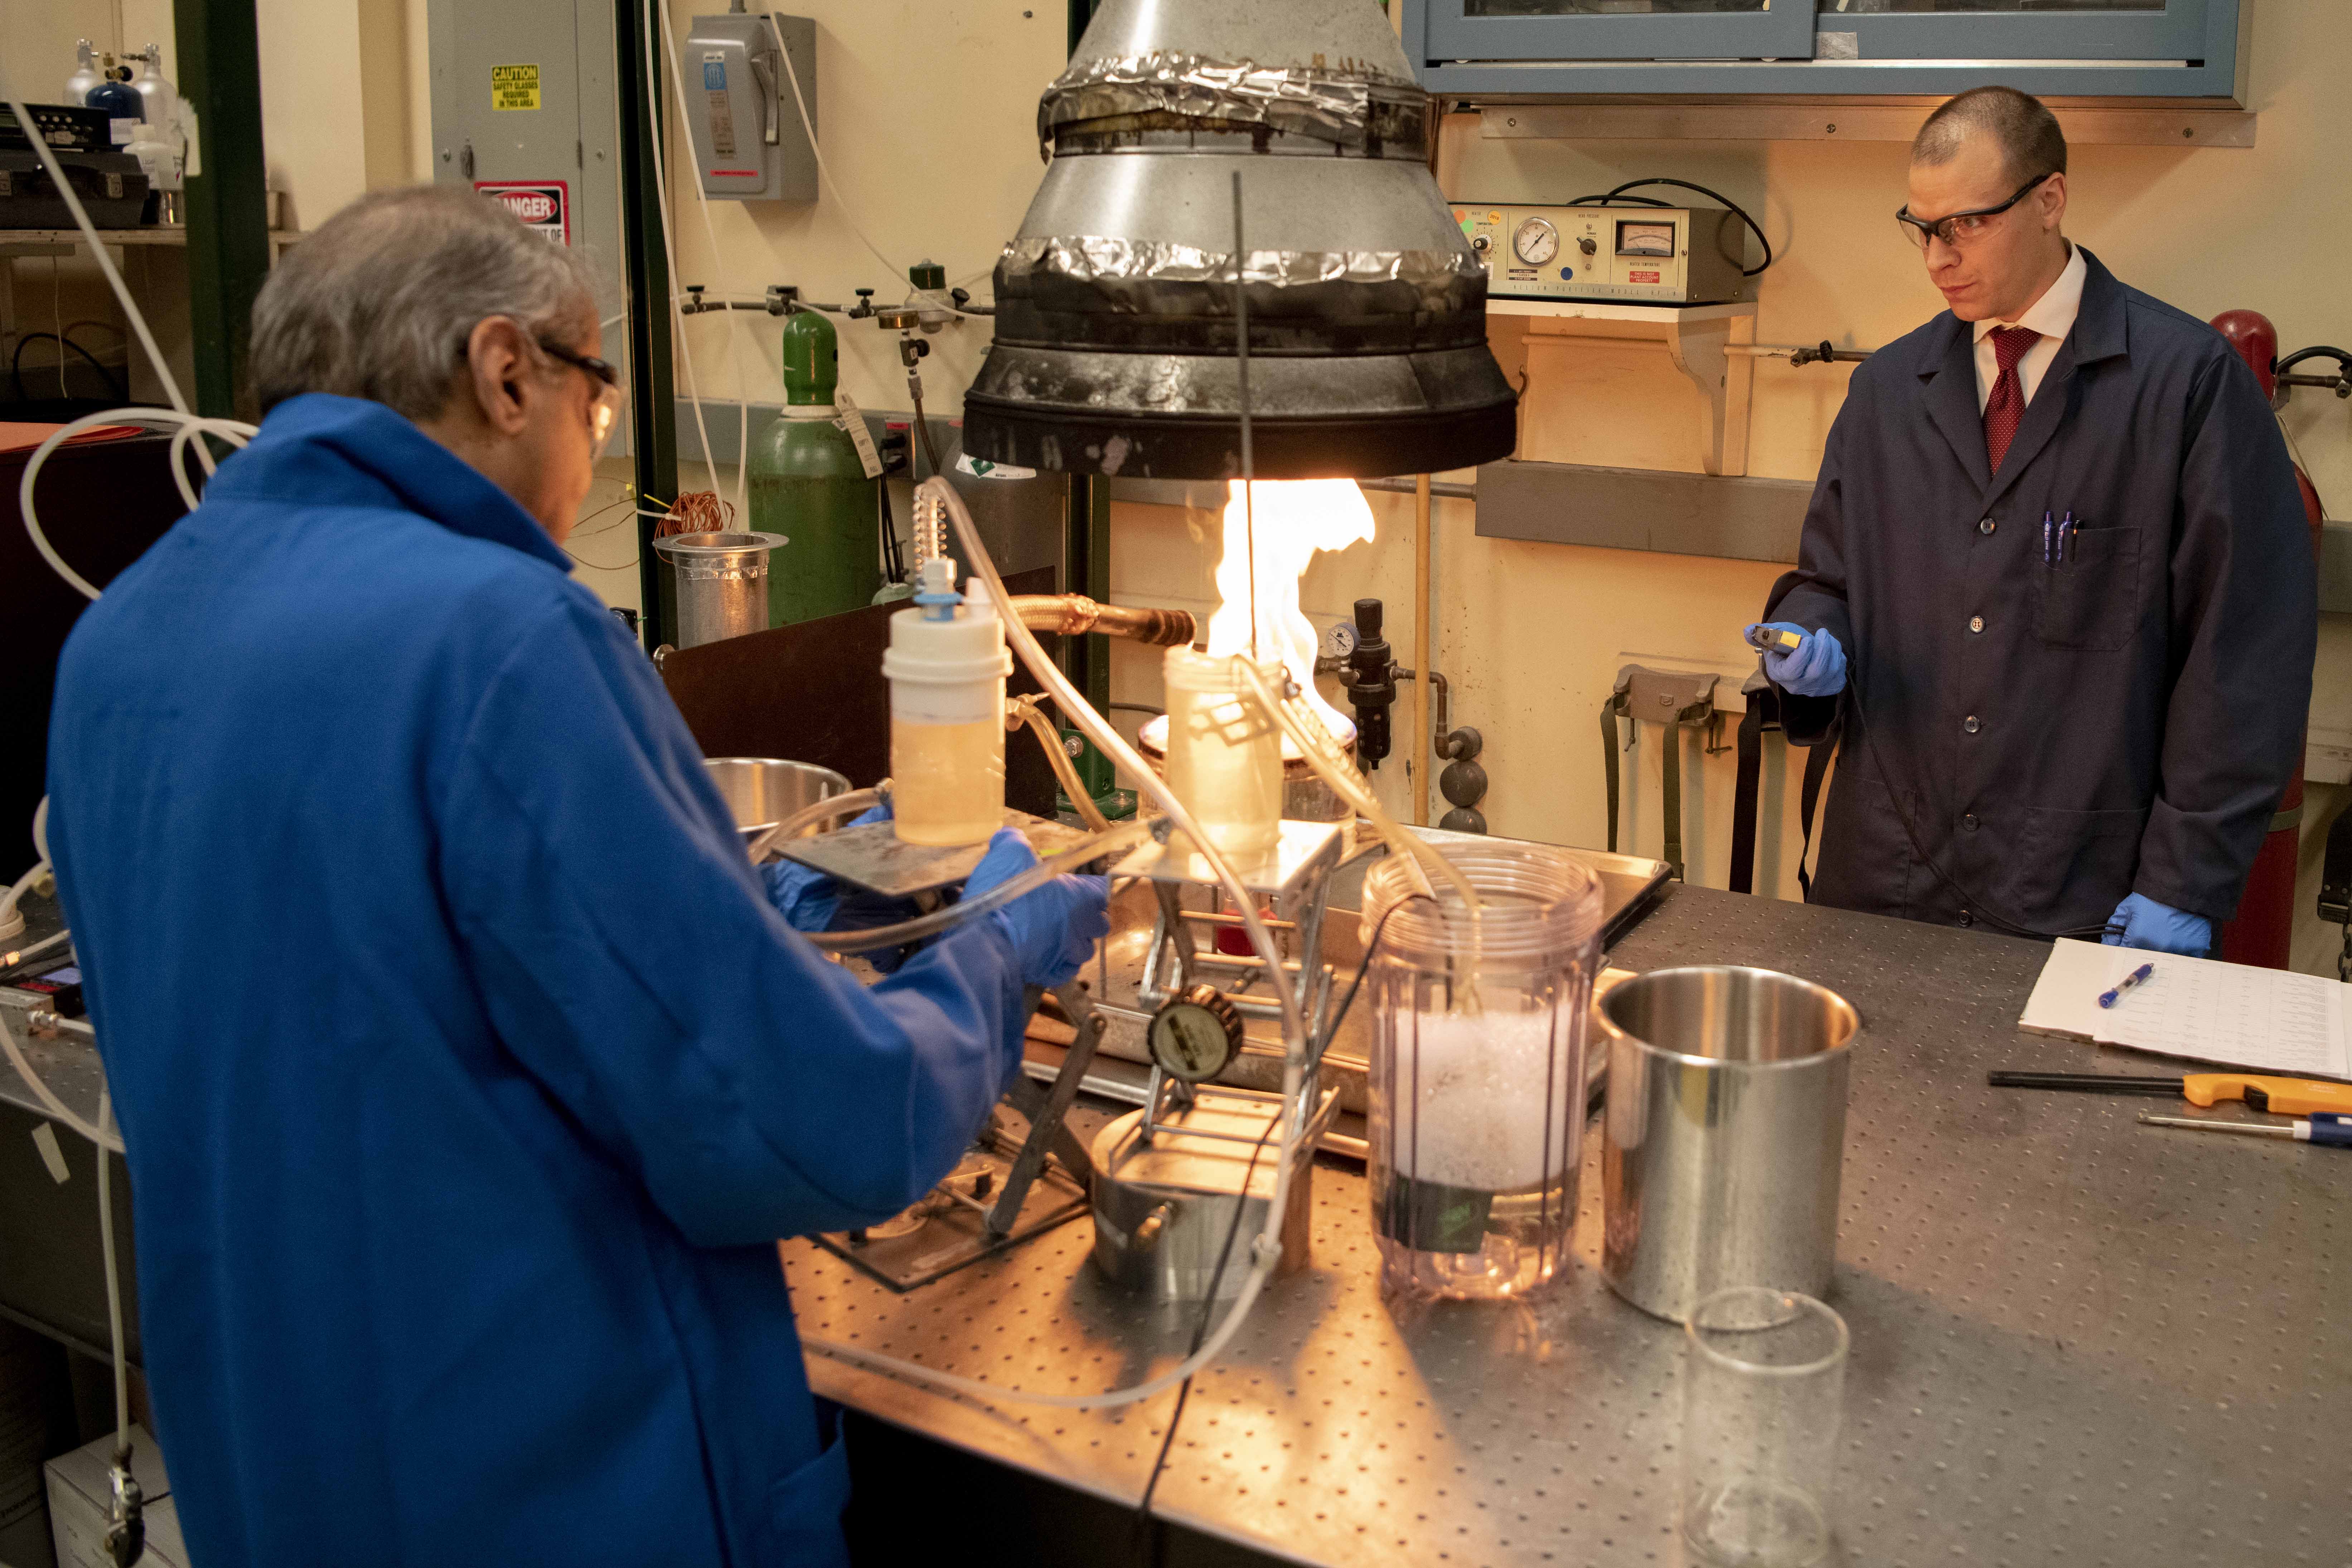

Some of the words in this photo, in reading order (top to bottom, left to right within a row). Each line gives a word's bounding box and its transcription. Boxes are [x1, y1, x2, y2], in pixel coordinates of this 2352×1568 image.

[494, 67, 537, 79] CAUTION
[493, 82, 514, 90] SAFETY
[503, 197, 551, 217] ANGER
